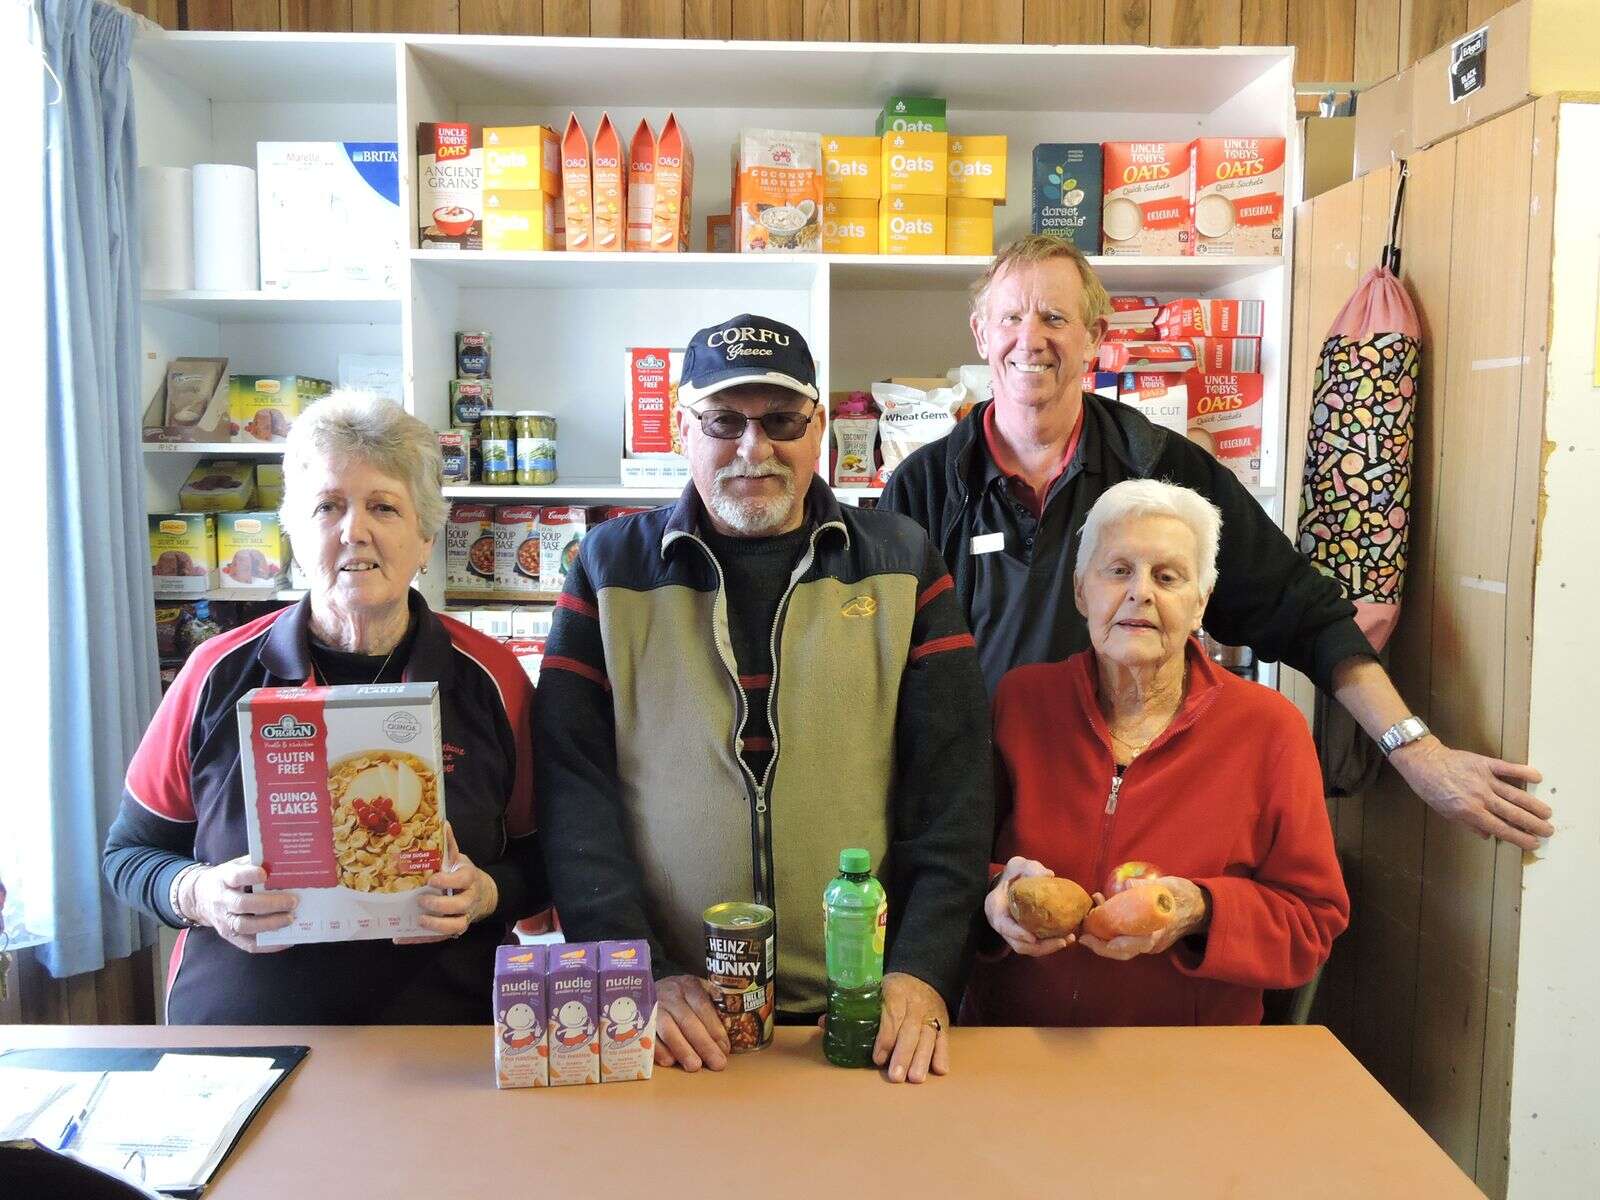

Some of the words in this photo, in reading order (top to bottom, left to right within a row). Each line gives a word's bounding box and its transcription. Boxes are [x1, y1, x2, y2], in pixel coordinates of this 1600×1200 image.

[1460, 67, 1477, 84] BLACK
[892, 118, 933, 132] Oats
[438, 128, 467, 137] UNCLE
[438, 136, 467, 145] TOBYS
[1224, 139, 1259, 149] UNCLE
[438, 145, 467, 157] OATS
[1130, 144, 1164, 153] UNCLE
[363, 151, 398, 162] BRITA
[1130, 153, 1164, 163] TOBYS
[1224, 150, 1259, 160] TOBYS
[826, 159, 868, 177] Oats
[890, 154, 934, 172] Oats
[949, 159, 993, 177] Oats
[424, 166, 483, 178] ANCIENT
[751, 169, 814, 181] COCONUT
[1123, 164, 1171, 184] OATS
[1216, 159, 1265, 180] OATS
[428, 177, 479, 189] GRAINS
[760, 177, 805, 188] HONEY
[1042, 206, 1079, 216] dorset
[890, 217, 933, 234] Oats
[1042, 216, 1084, 227] cereals
[823, 221, 866, 238] Oats
[1042, 227, 1075, 238] simply
[707, 327, 790, 348] CORFU
[726, 342, 773, 361] Greece
[1205, 376, 1238, 385] UNCLE
[1205, 385, 1239, 395] TOBYS
[1197, 393, 1244, 414] OATS
[886, 413, 918, 422] Wheat
[920, 411, 948, 420] Germ
[1160, 407, 1181, 416] CUT
[1196, 415, 1215, 426] Quick
[448, 530, 469, 540] SOUP
[495, 531, 516, 541] SOUP
[541, 532, 561, 542] SOUP
[448, 539, 468, 549] BASE
[495, 540, 515, 550] BASE
[541, 541, 561, 551] BASE
[262, 725, 315, 738] ORGRAN
[267, 752, 315, 764] GLUTEN
[278, 764, 305, 775] FREE
[269, 792, 318, 803] QUINOA
[270, 802, 319, 815] FLAKES
[709, 938, 746, 955] HEINZ
[715, 953, 737, 962] BIG'N
[706, 958, 761, 977] CHUNKY
[502, 980, 539, 993] nudie
[555, 977, 592, 990] nudie
[606, 975, 642, 988] nudie
